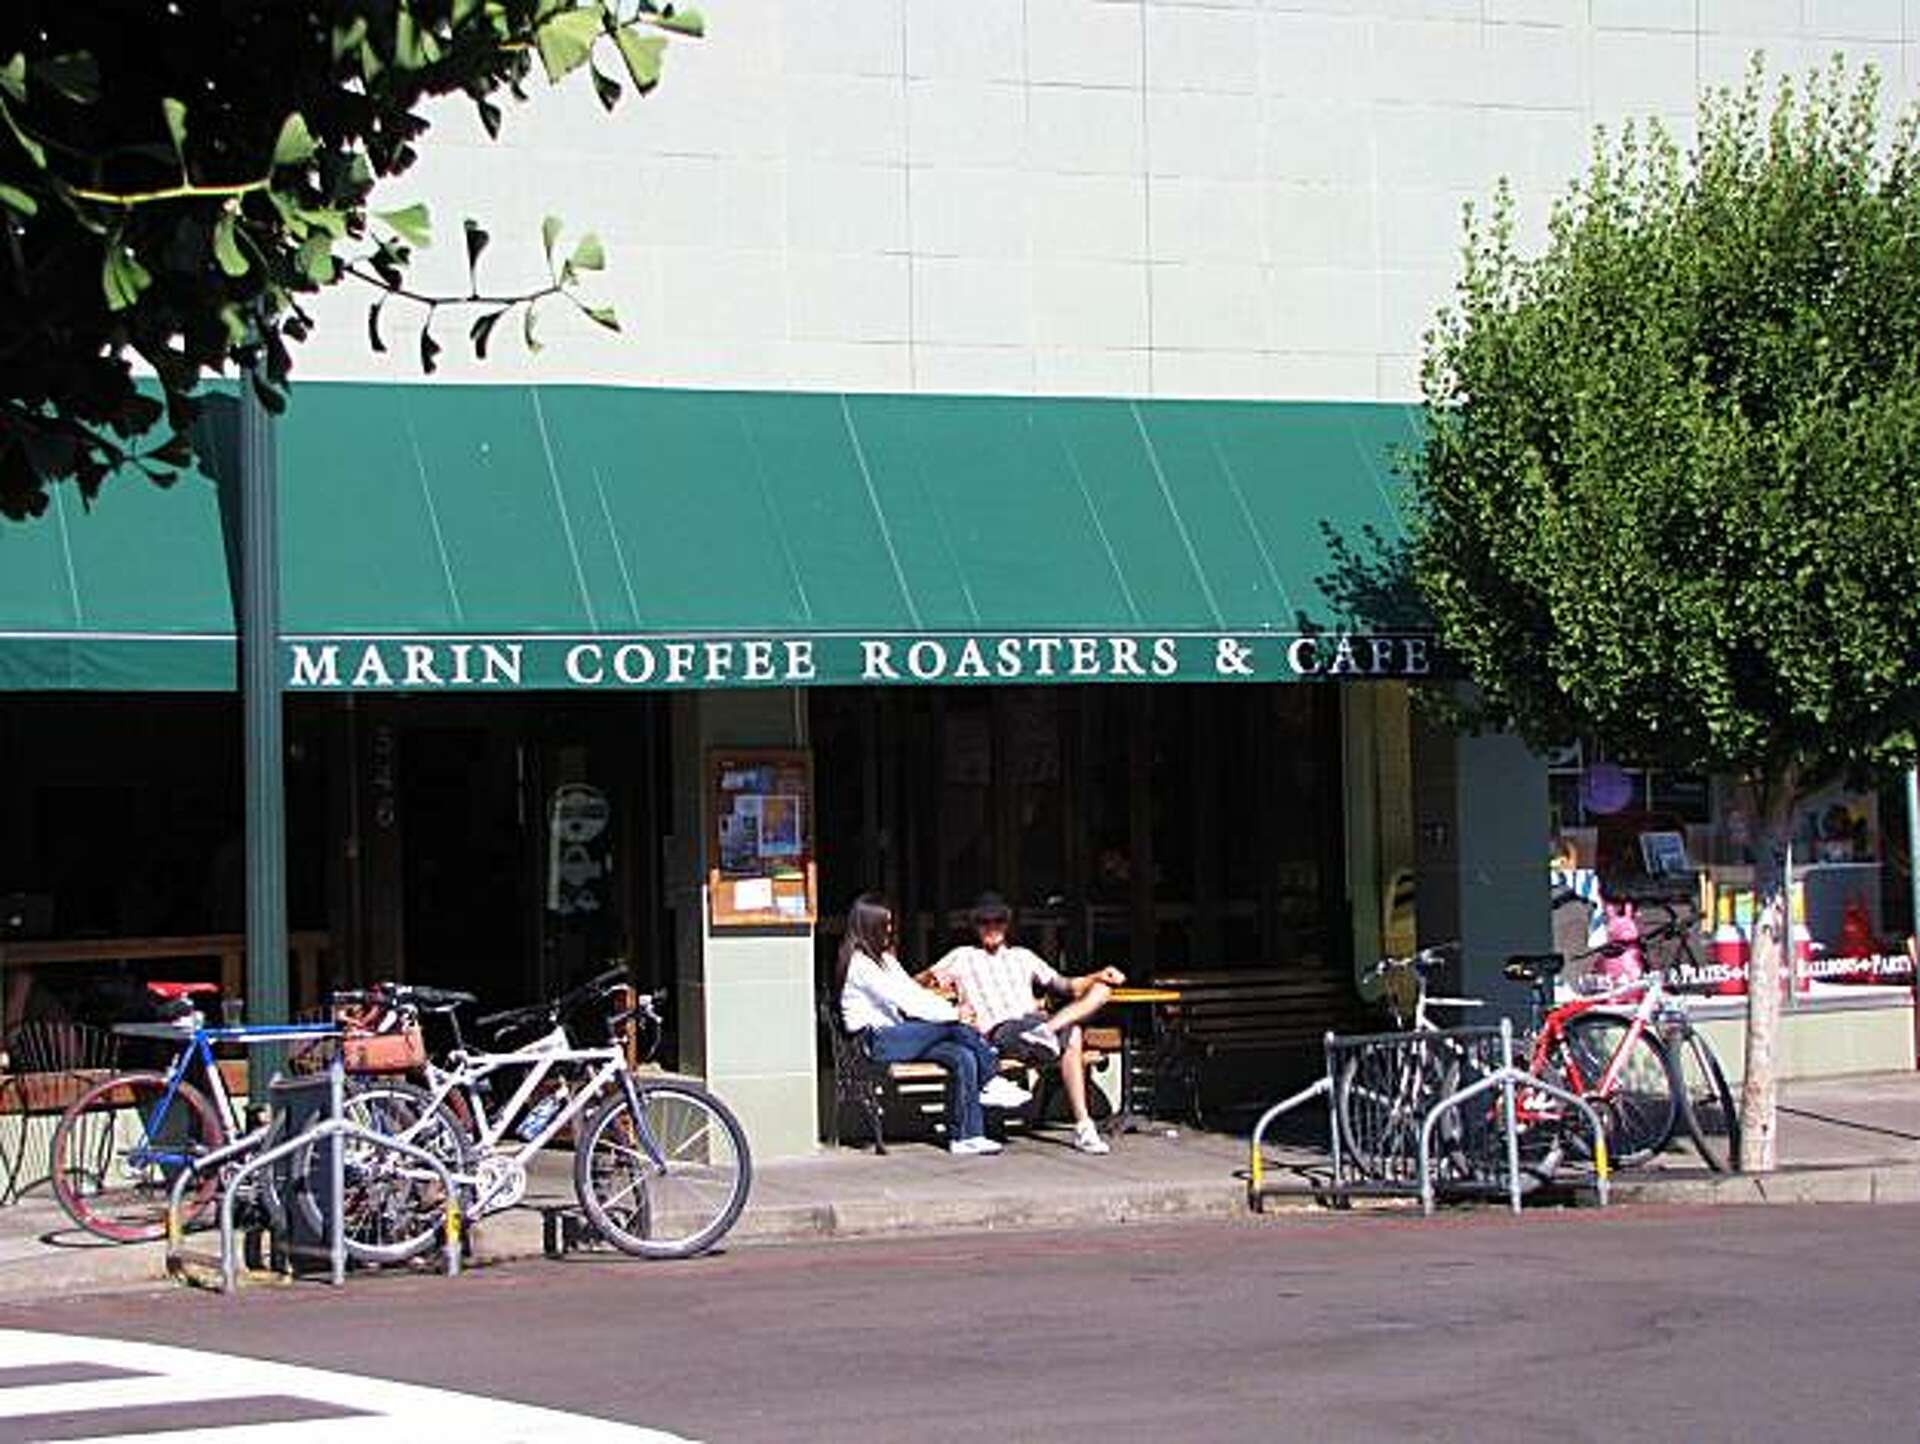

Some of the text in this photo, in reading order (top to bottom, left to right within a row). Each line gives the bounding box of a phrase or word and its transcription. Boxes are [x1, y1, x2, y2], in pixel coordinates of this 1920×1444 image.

[290, 637, 1429, 687] MARIN COFFEE ROASTERS & CAFE
